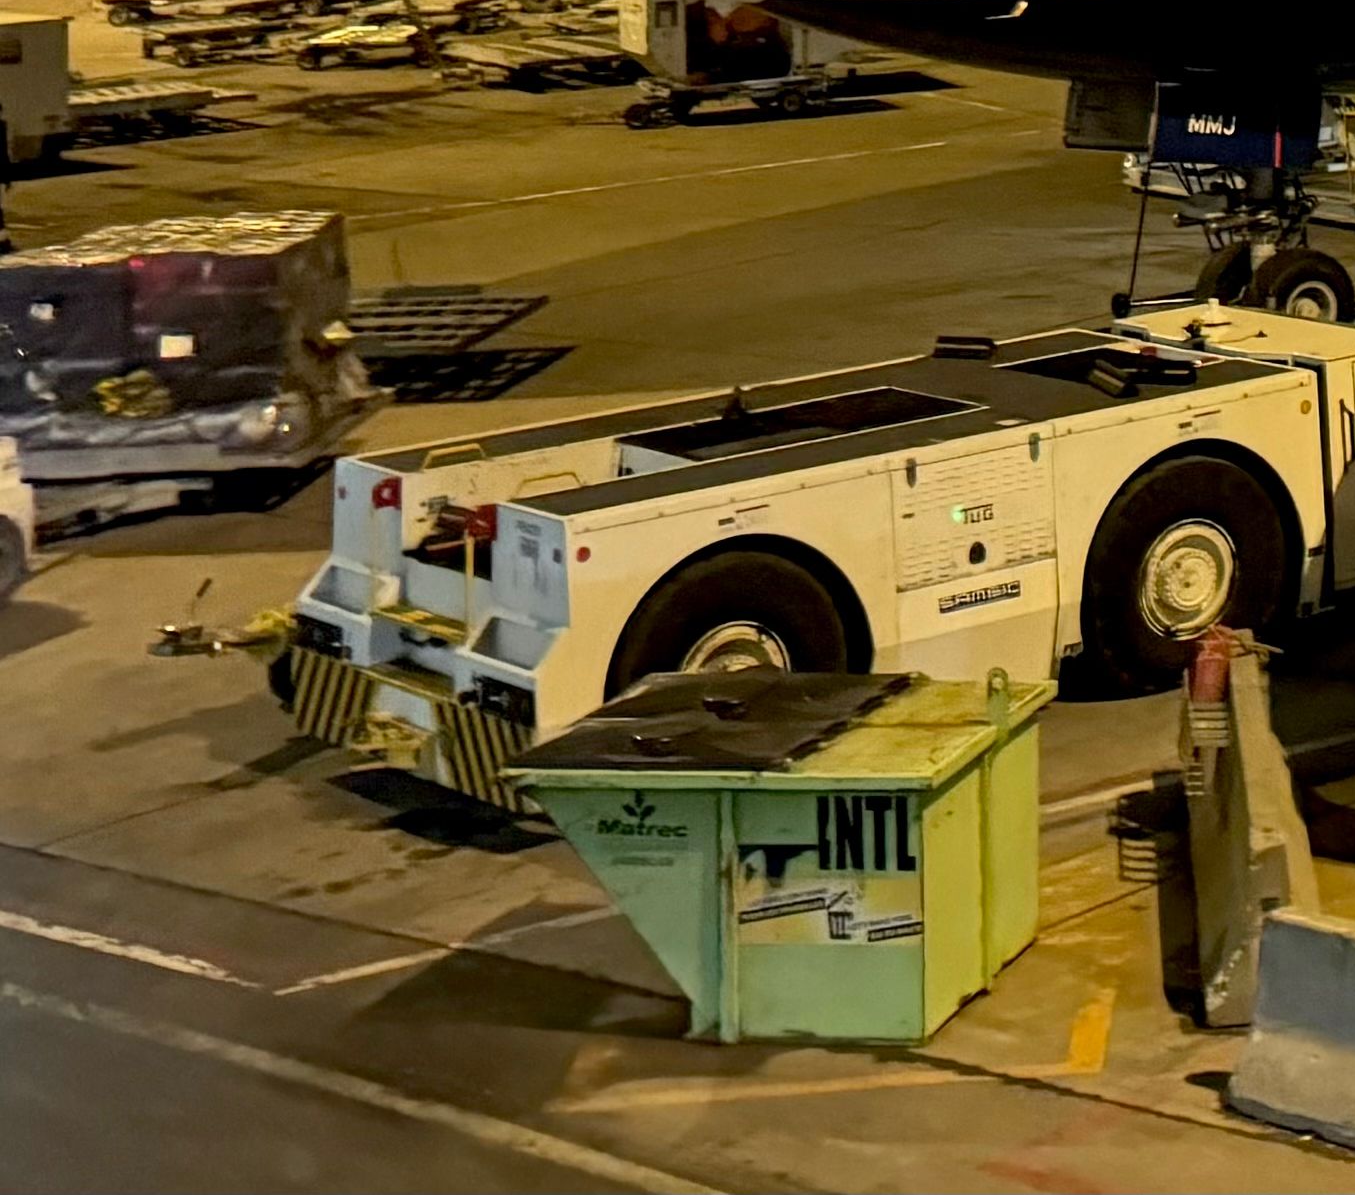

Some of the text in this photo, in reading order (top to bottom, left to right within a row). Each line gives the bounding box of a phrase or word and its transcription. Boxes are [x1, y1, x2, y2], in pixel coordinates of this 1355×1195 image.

[1187, 113, 1237, 136] MMJ
[958, 504, 994, 524] TUG
[597, 819, 689, 838] Matrec
[816, 795, 917, 871] INTL
